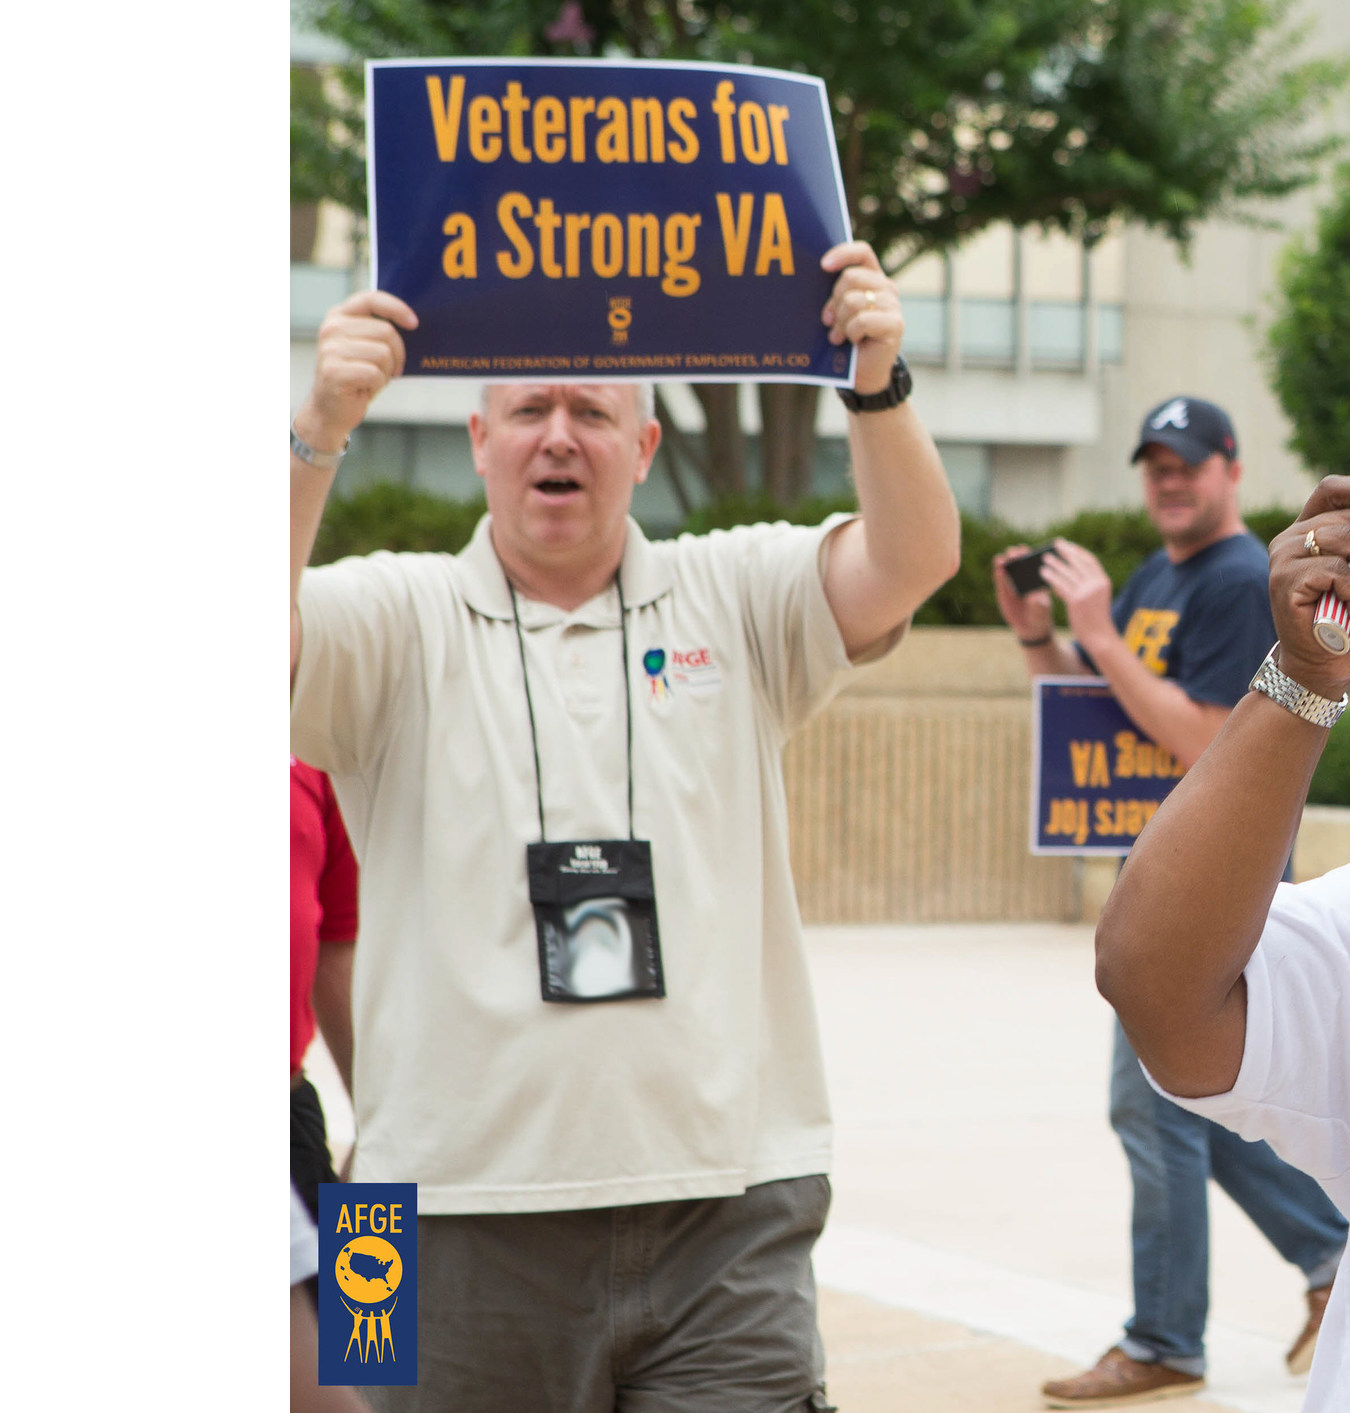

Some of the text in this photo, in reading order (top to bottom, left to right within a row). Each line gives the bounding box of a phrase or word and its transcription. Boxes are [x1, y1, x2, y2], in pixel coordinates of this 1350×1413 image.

[425, 75, 790, 166] Veterans for
[441, 191, 796, 298] a Strong VA
[421, 357, 490, 369] AMERICAN
[493, 356, 571, 369] FEDERATION
[573, 356, 590, 368] OF
[593, 355, 682, 368] GOVERNMENT
[762, 353, 811, 367] AFL-CIO
[1069, 739, 1110, 788] VA
